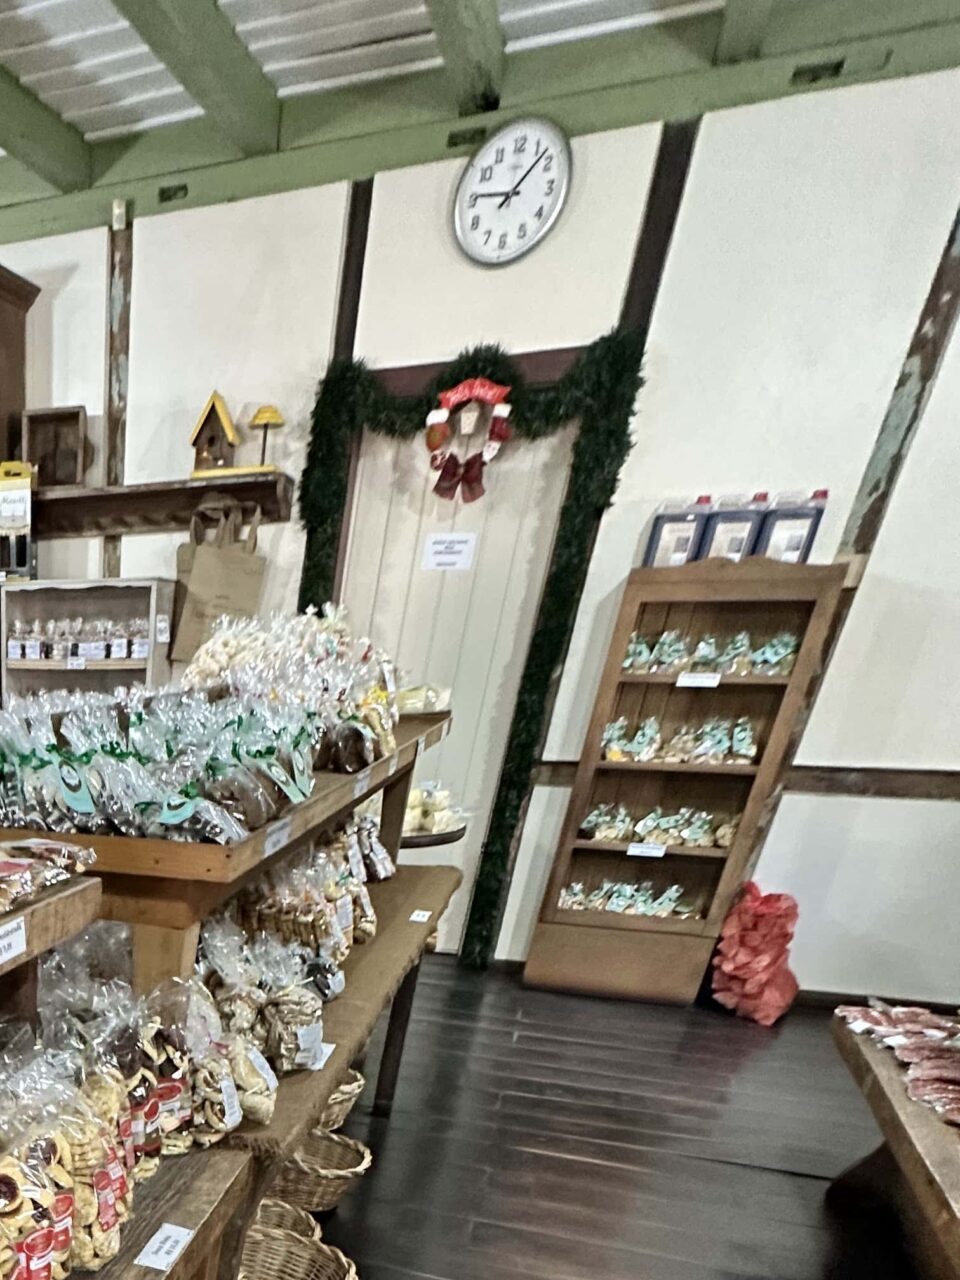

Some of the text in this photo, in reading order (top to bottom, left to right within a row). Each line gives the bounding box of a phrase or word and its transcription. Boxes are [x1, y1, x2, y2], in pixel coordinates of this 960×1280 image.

[513, 134, 528, 155] 12
[535, 139, 541, 157] 1
[494, 147, 505, 165] 11
[543, 154, 554, 172] 2
[479, 165, 493, 183] 10
[544, 178, 555, 197] 3
[468, 192, 478, 209] 9
[533, 204, 544, 221] 4
[470, 215, 480, 231] 8
[517, 222, 526, 239] 5
[483, 230, 492, 245] 7
[498, 232, 508, 250] 6
